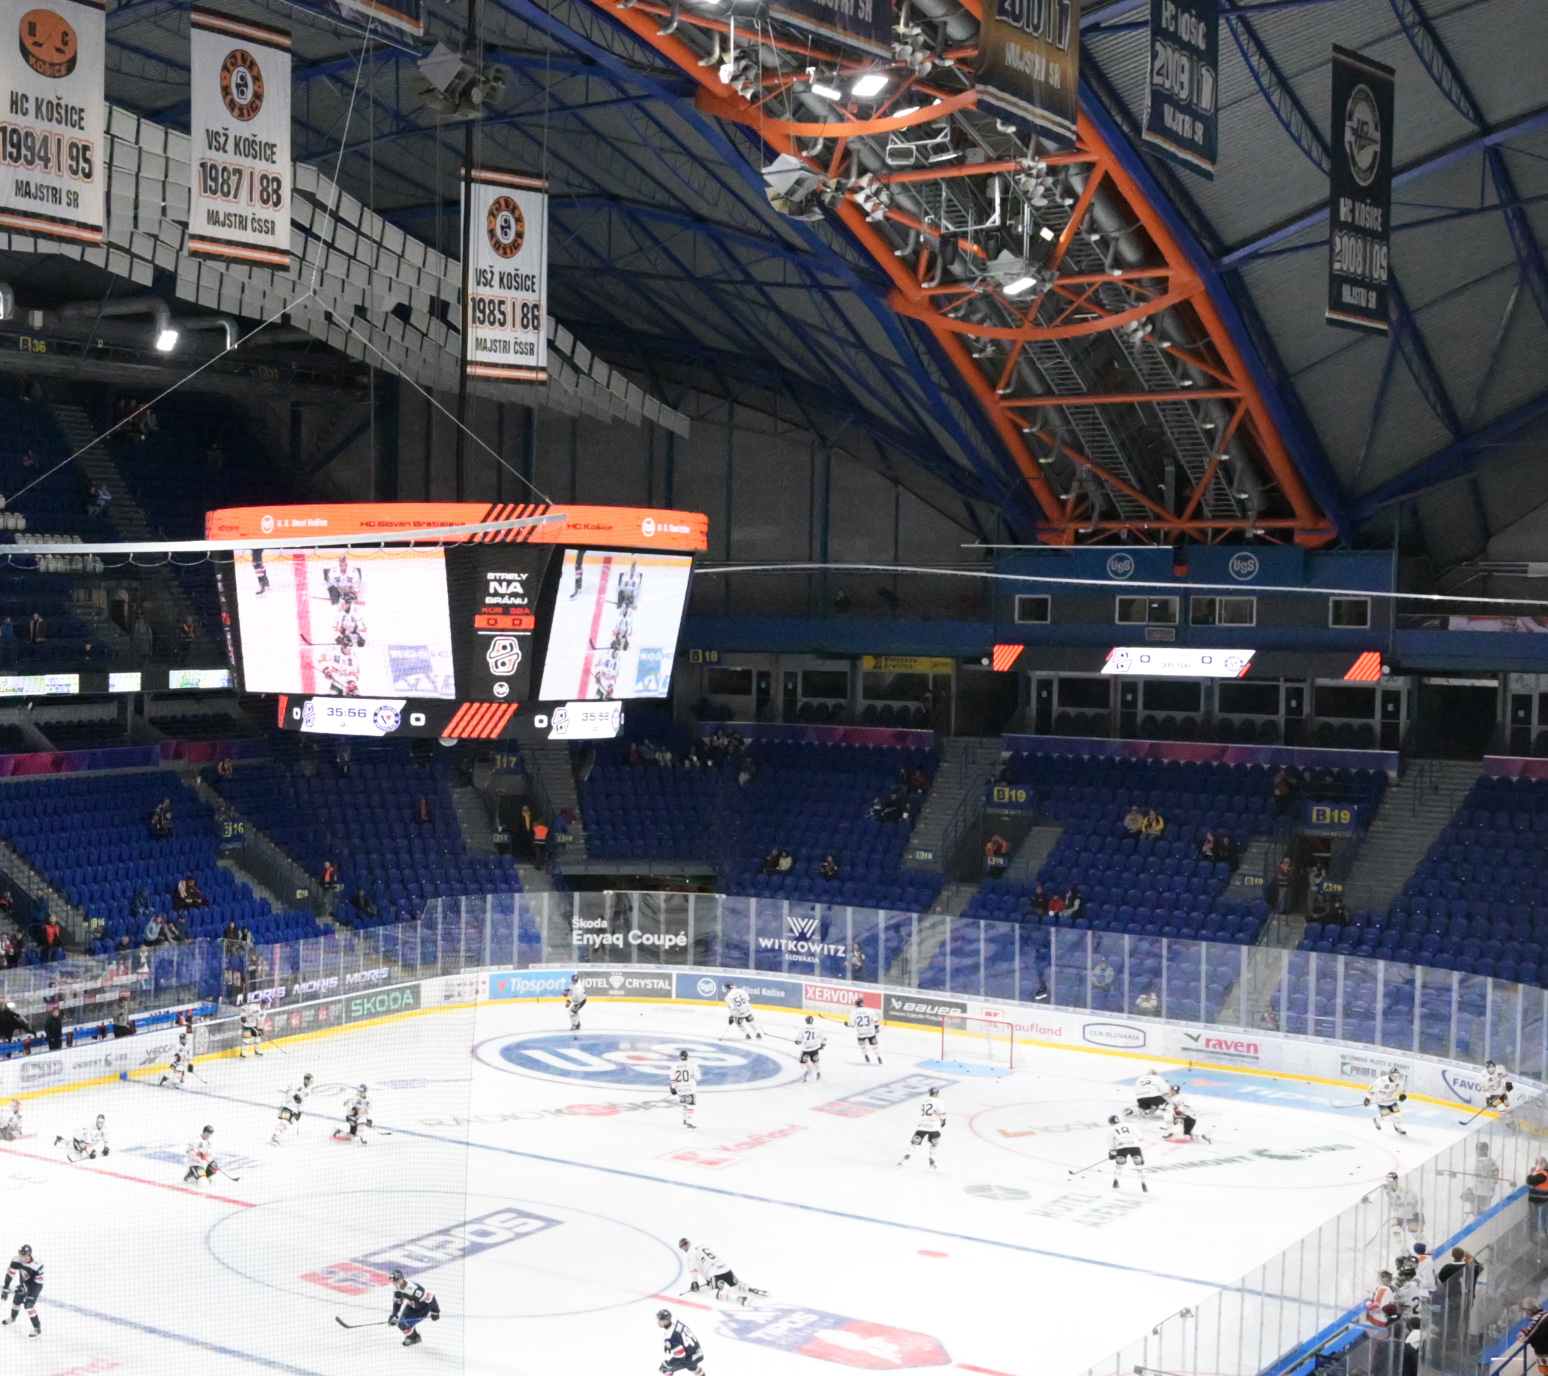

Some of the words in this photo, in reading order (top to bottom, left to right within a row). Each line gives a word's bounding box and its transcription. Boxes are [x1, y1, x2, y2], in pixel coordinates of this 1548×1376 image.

[10, 90, 30, 116] HC
[35, 96, 85, 132] KOŠICE
[206, 128, 229, 155] VSŽ
[233, 134, 277, 165] KOŠICE
[15, 178, 62, 205] MAJSTRI
[65, 190, 79, 210] SR
[206, 207, 248, 232] MAJSTRI
[250, 208, 276, 237] ČSSR
[475, 265, 494, 288] VSŽ
[499, 267, 536, 293] KOŠICE
[475, 337, 510, 354] MAJSTRI
[513, 336, 535, 356] ČSSR
[360, 520, 376, 528] HC
[378, 520, 411, 528] Slovan
[566, 522, 582, 531] HC
[487, 572, 529, 581] STRELY
[489, 581, 524, 595] NA
[485, 595, 529, 605] BRÁNU
[326, 707, 367, 719] 35:56
[572, 917, 608, 929] Škoda
[572, 929, 625, 950] Enyaq
[628, 929, 687, 947] Coupé
[758, 935, 847, 959] WITKOWITZ
[510, 976, 566, 995] Tipsport
[578, 977, 607, 991] HOTEL
[625, 977, 672, 992] CRYSTAL
[857, 1015, 871, 1027] 23
[1204, 1036, 1260, 1056] raven
[674, 1069, 690, 1083] 20
[378, 1205, 554, 1277] TIPOS
